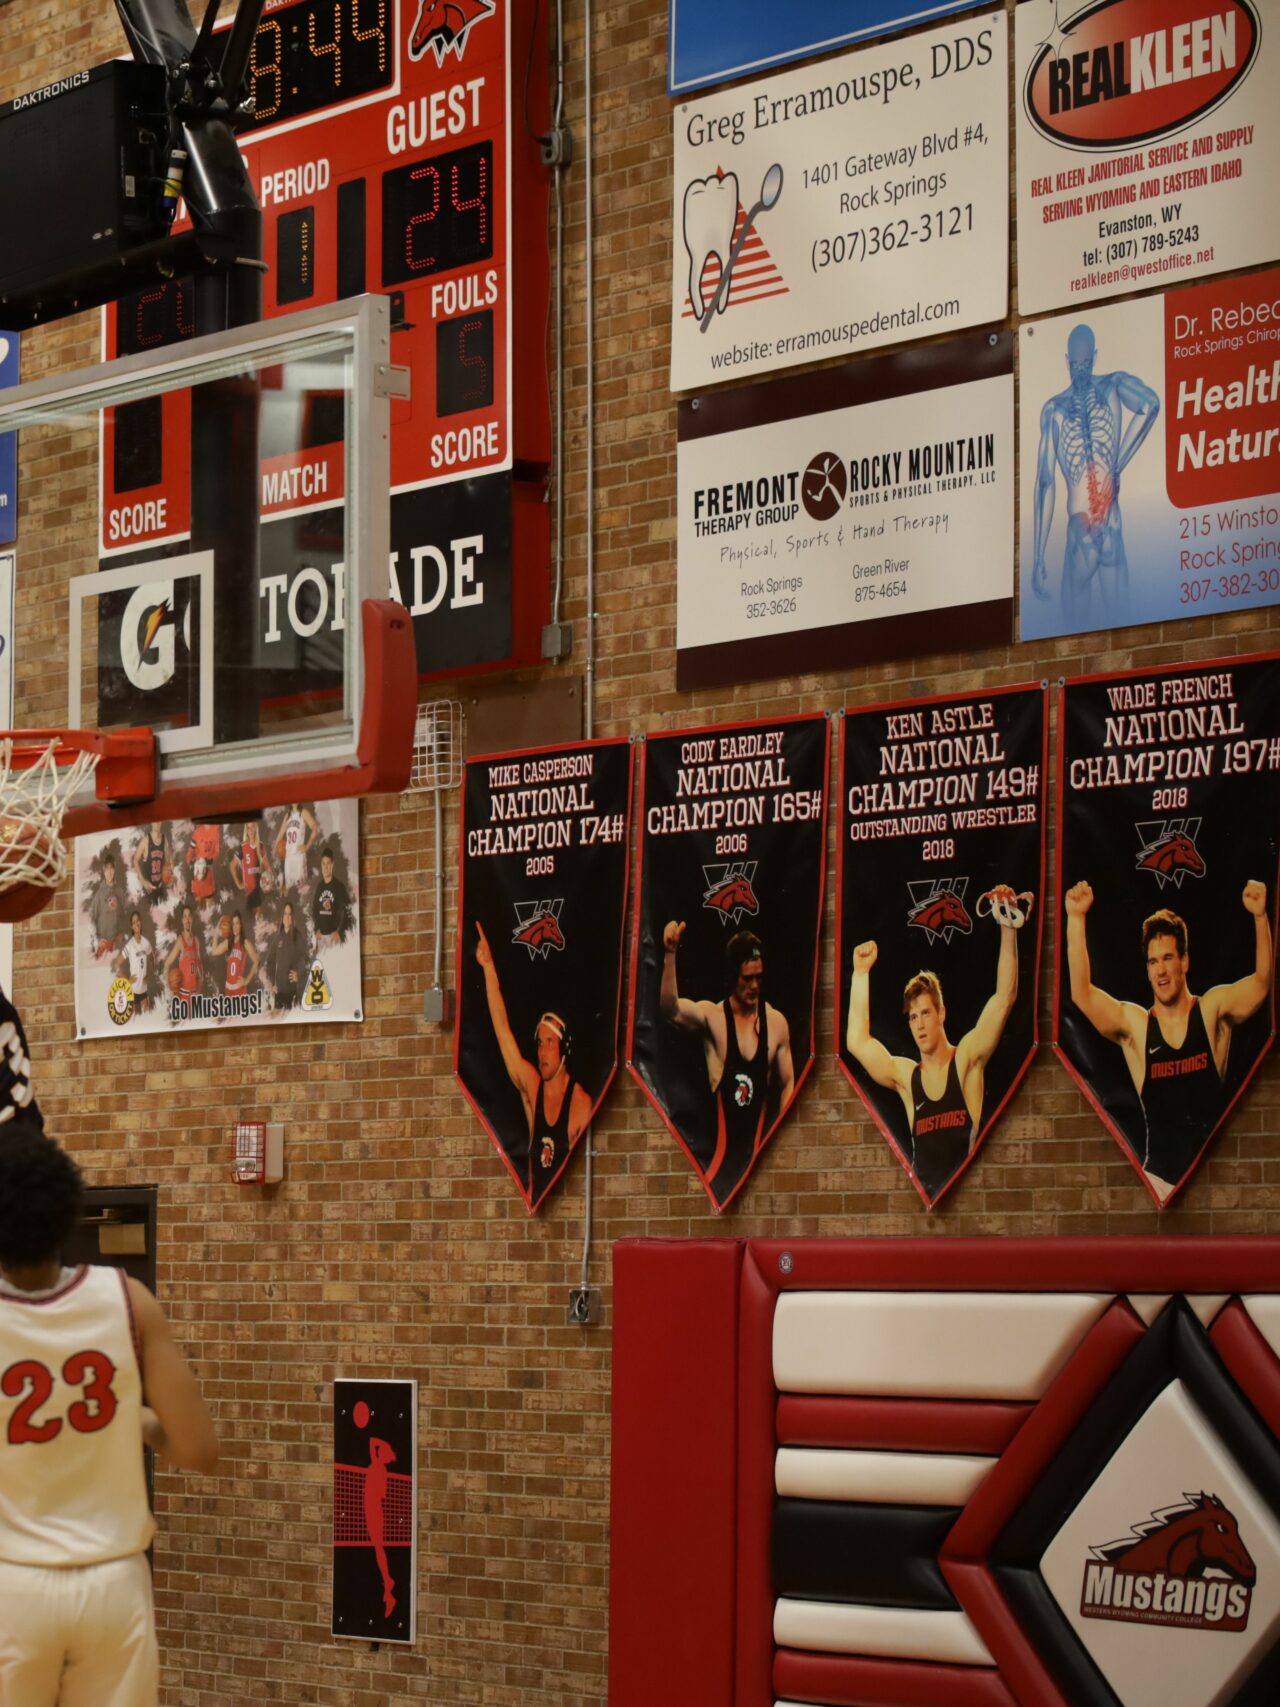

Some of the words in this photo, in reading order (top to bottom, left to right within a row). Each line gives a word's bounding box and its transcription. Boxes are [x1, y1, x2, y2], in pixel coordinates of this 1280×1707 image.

[249, 0, 386, 120] 8:44
[13, 70, 90, 111] DAKTRONICS
[686, 110, 746, 147] Greg
[753, 60, 921, 130] Erramouspe,
[930, 29, 994, 80] DDS
[386, 77, 486, 155] GUEST
[802, 160, 840, 190] 1401
[844, 142, 918, 178] Gateway
[922, 127, 959, 159] Blvd
[963, 122, 989, 147] #4,
[1031, 175, 1054, 198] REAL
[1056, 167, 1086, 192] KLEEN
[1087, 152, 1146, 184] JANITORIAL
[1147, 141, 1189, 170] SERVICE
[1191, 135, 1214, 158] AND
[1216, 125, 1255, 154] SUPPLY
[261, 158, 331, 208] PERIOD
[839, 185, 880, 214] Rock
[883, 171, 948, 206] Springs
[1042, 196, 1084, 225] SERVING
[1085, 183, 1138, 214] WYOMING
[1138, 179, 1161, 202] AND
[1162, 166, 1209, 196] EASTERN
[1210, 158, 1243, 184] IDAHO
[404, 156, 487, 271] 24
[1098, 211, 1158, 239] Evanston,
[1161, 203, 1183, 224] WY
[300, 221, 309, 284] 1
[811, 203, 974, 273] (307)362-3121
[1083, 248, 1103, 268] tel:
[1106, 239, 1139, 265] (307)
[1142, 224, 1200, 253] 789-5243
[1070, 246, 1216, 293] realkleen@qwestoffice.net
[431, 270, 499, 319] FOULS
[711, 339, 774, 370] website:
[775, 299, 961, 356] erramouspedental.com
[1173, 343, 1202, 360] Rock
[1204, 335, 1245, 358] Springs
[1174, 312, 1204, 341] Dr.
[431, 421, 500, 469] SCORE
[849, 450, 902, 493] ROCKY
[908, 433, 995, 484] MOUNTAIN
[262, 461, 329, 506] MATCH
[694, 471, 800, 520] FREMONT
[849, 489, 881, 509] SPORTS
[883, 488, 890, 502] &
[892, 481, 933, 501] PHYSICAL
[936, 474, 979, 493] THERAPY,
[980, 469, 997, 485] LLC
[109, 498, 168, 541] SCORE
[694, 511, 752, 539] THERAPY
[755, 503, 800, 529] GROUP
[719, 538, 778, 569] Physical,
[785, 531, 830, 561] Sports
[852, 520, 886, 542] Hand
[892, 511, 950, 537] Therapy
[1179, 513, 1212, 540] 215
[852, 560, 882, 581] Green
[883, 557, 910, 575] River
[1180, 545, 1226, 572] Rock
[740, 581, 765, 598] Rock
[766, 574, 804, 595] Springs
[854, 580, 908, 604] 875-4654
[746, 596, 797, 620] 352-3626
[1107, 682, 1158, 713] WADE
[1161, 673, 1234, 706] FRENCH
[886, 712, 924, 740] KEN
[931, 703, 995, 736] ASTLE
[1103, 702, 1246, 749] NATIONAL
[681, 741, 716, 765] CODY
[719, 731, 785, 761] EARDLEY
[879, 732, 1006, 777] NATIONAL
[1069, 745, 1215, 791] CHAMPION
[1221, 737, 1280, 775] 197#
[488, 764, 521, 789] MIKE
[523, 754, 595, 784] CASPERSON
[676, 758, 792, 798] NATIONAL
[848, 772, 979, 816] CHAMPION
[985, 765, 1040, 801] 149#
[490, 783, 595, 822] NATIONAL
[647, 796, 766, 836] CHAMPION
[772, 790, 823, 823] 165#
[1152, 787, 1189, 811] 2018
[467, 820, 572, 858] CHAMPION
[579, 814, 625, 846] 174#
[850, 811, 948, 842] OUTSTANDING
[951, 803, 1038, 831] WRESTLER
[715, 834, 748, 855] 2006
[922, 838, 955, 862] 2018
[526, 856, 555, 877] 2005
[171, 996, 189, 1021] Go
[190, 989, 263, 1020] Mustangs!
[1151, 1052, 1209, 1080] MUSTANGS
[915, 1109, 967, 1136] MUSTANGS
[0, 1349, 119, 1446] 23
[1084, 1563, 1249, 1622] Mustangs
